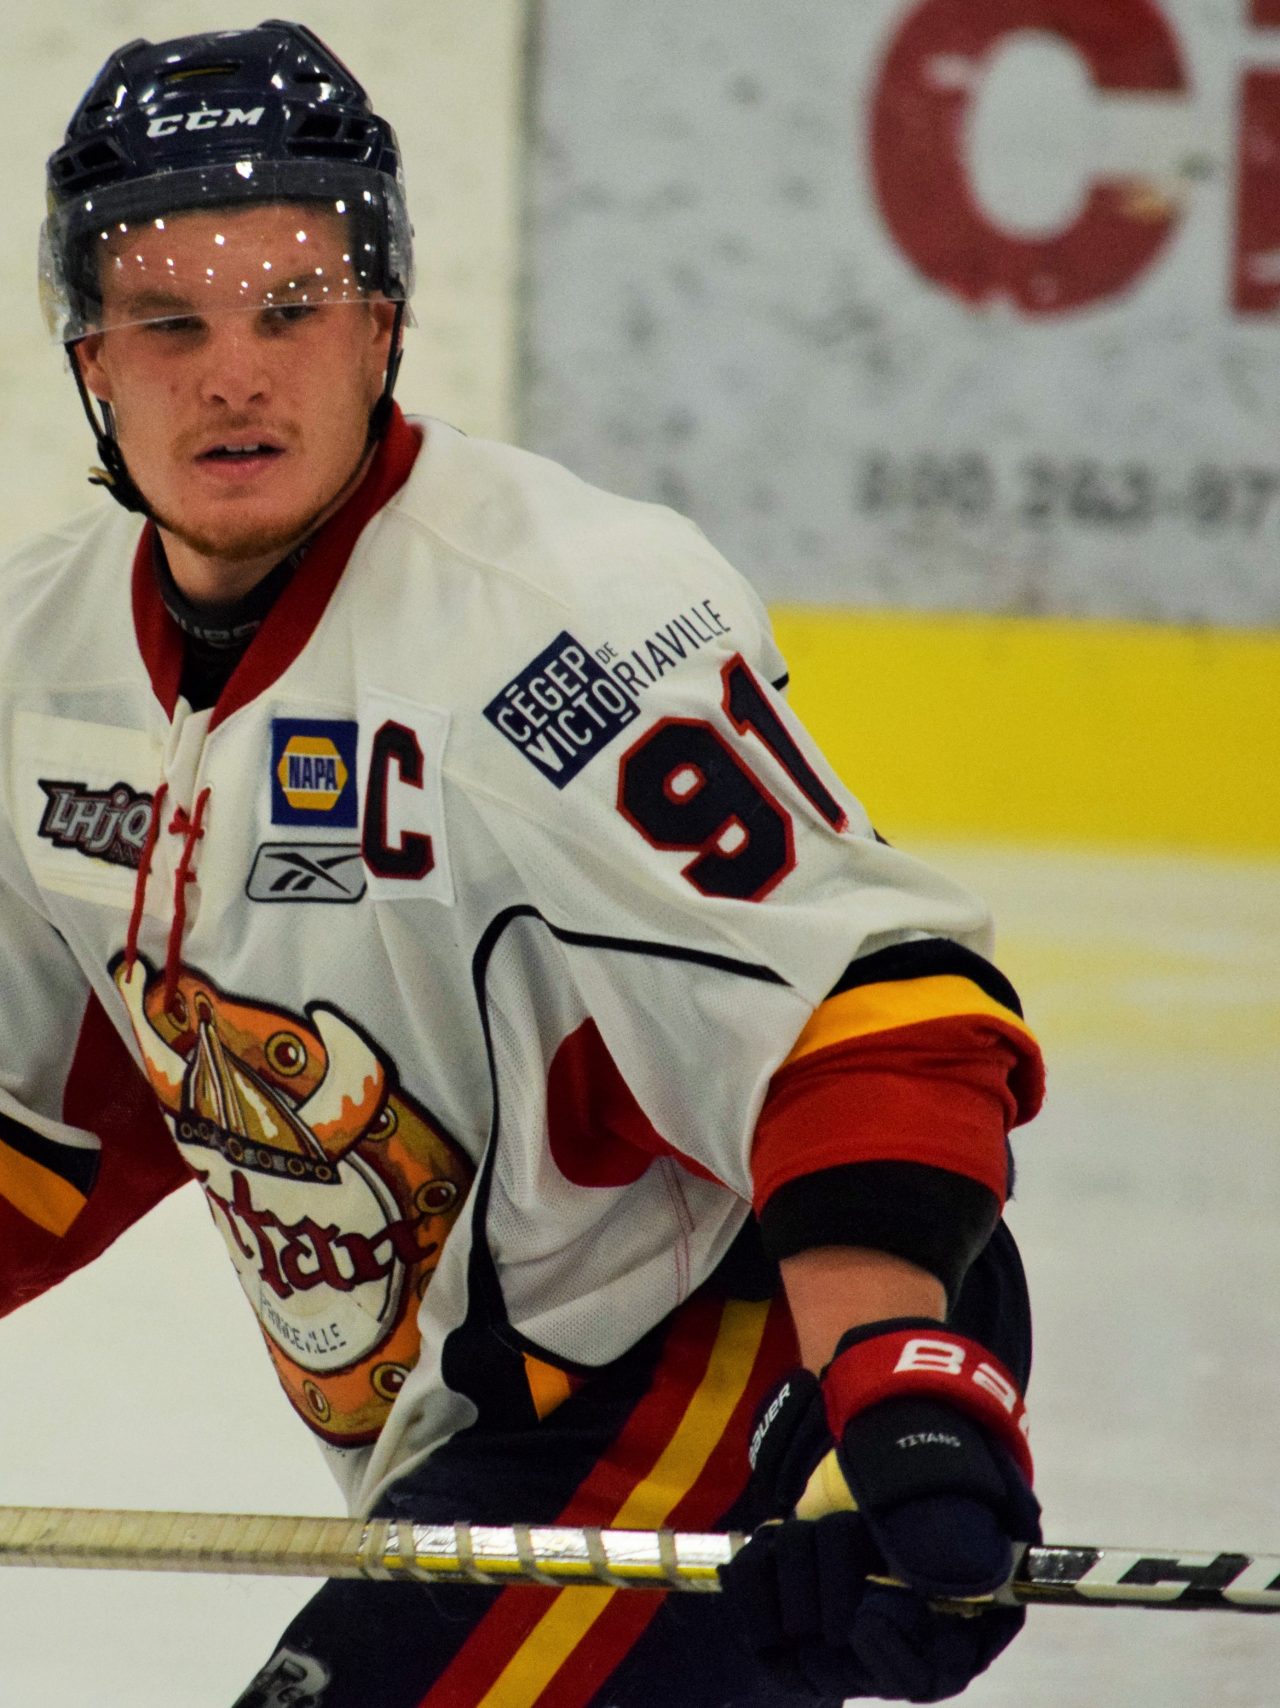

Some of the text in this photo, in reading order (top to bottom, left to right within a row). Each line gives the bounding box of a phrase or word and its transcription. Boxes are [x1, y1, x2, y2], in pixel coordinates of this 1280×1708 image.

[146, 107, 265, 138] CCM
[595, 641, 618, 665] DE
[526, 599, 731, 774] VICTORIAVILLE
[288, 755, 339, 791] NAPA
[616, 652, 849, 904] 91
[362, 719, 435, 880] C
[896, 1432, 961, 1449] TITANS
